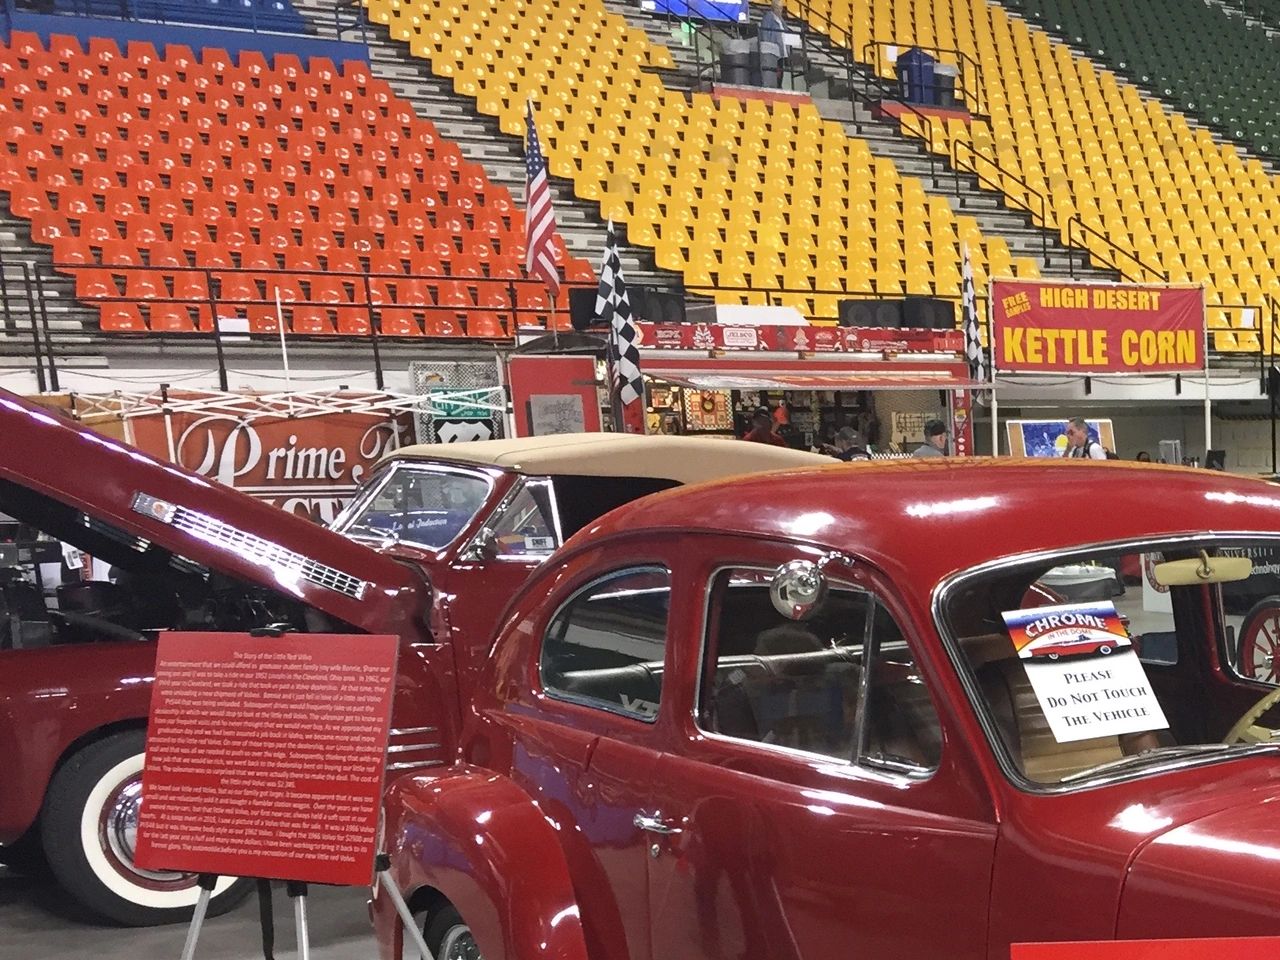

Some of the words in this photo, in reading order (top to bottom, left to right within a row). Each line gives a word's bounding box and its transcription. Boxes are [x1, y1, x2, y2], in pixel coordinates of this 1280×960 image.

[1001, 291, 1029, 309] FREE
[1039, 287, 1089, 308] HIGH
[1093, 289, 1161, 311] DESERT
[1002, 326, 1109, 365] KETTLE
[1121, 328, 1196, 366] CORN
[177, 416, 346, 488] Prime
[1024, 612, 1109, 639] CHROME
